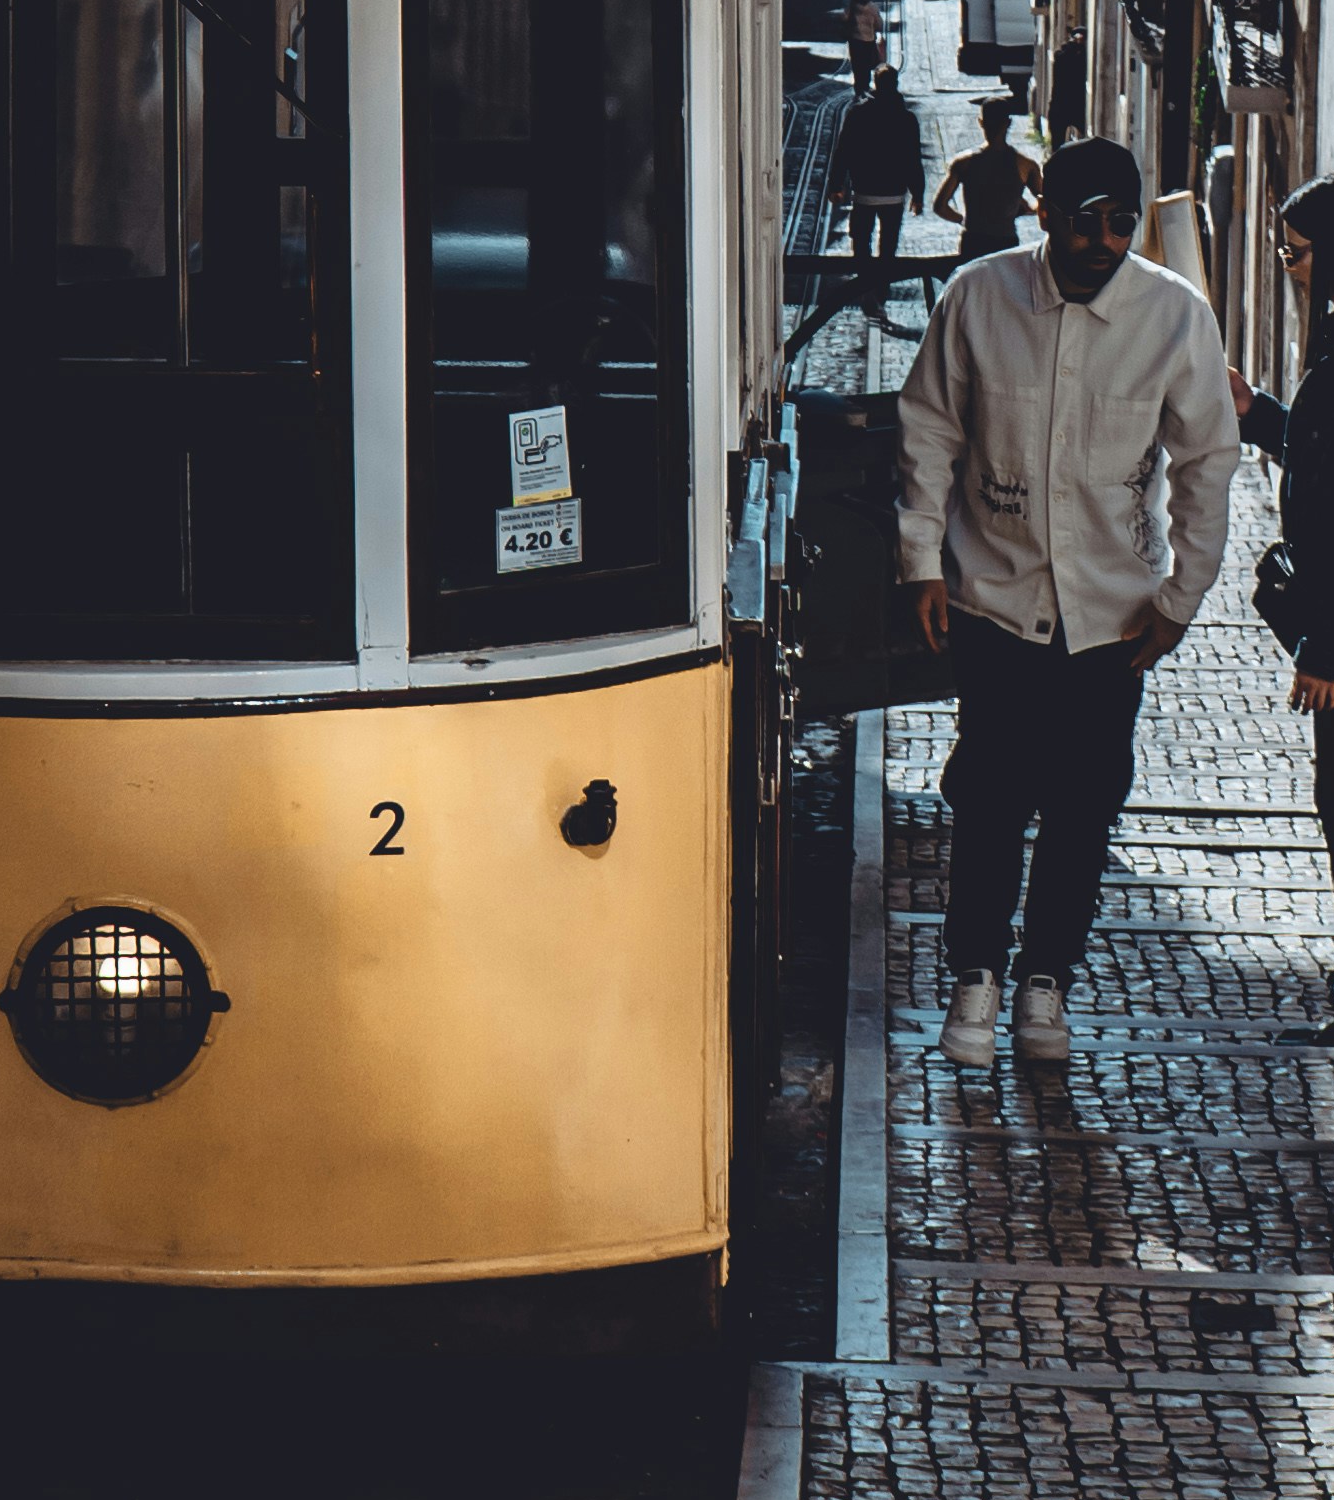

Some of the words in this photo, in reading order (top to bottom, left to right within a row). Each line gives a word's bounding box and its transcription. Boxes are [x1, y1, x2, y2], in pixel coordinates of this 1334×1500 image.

[505, 530, 553, 553] 4.20
[559, 527, 573, 546] €
[369, 801, 405, 856] 2
